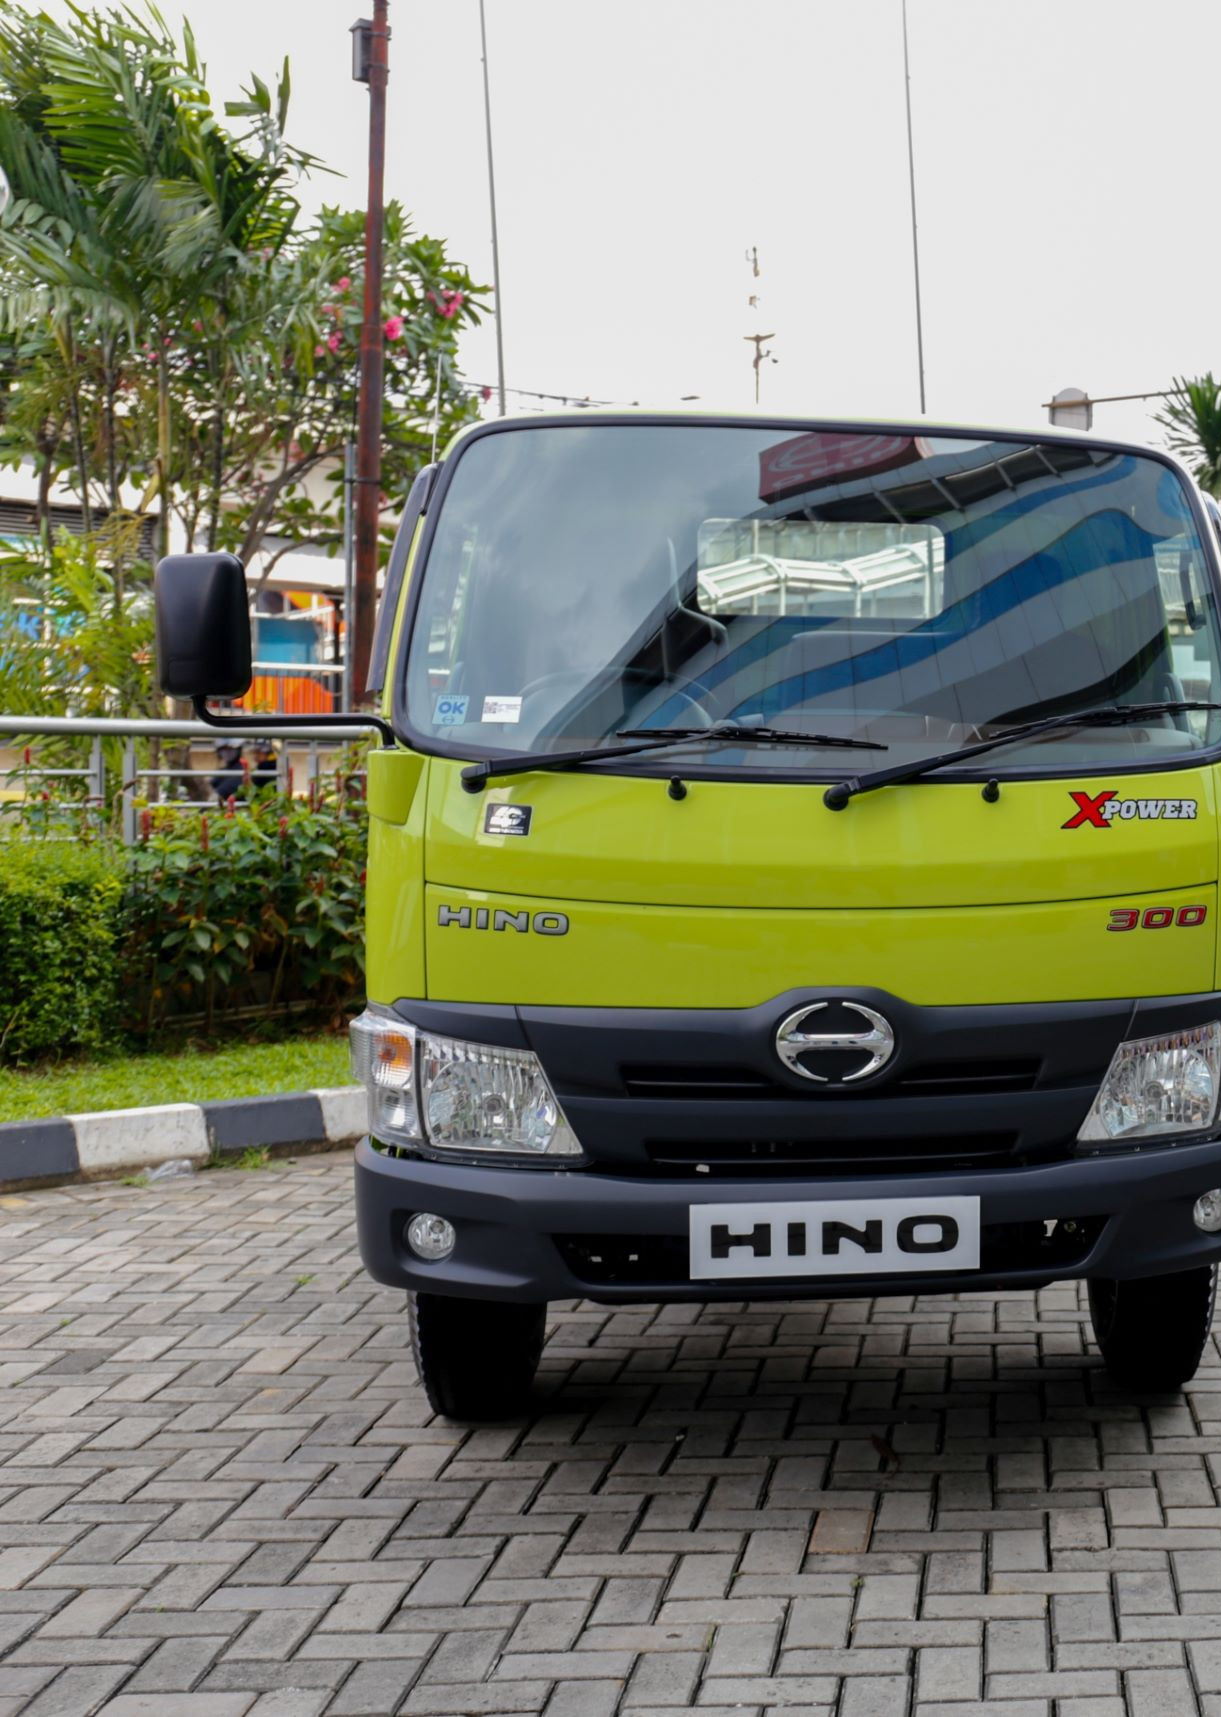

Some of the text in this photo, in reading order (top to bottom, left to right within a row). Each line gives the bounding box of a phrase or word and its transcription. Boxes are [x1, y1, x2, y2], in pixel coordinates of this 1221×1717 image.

[438, 701, 465, 715] OK
[438, 905, 570, 936] HINO
[1106, 905, 1207, 932] 300
[710, 1214, 959, 1259] HINO
